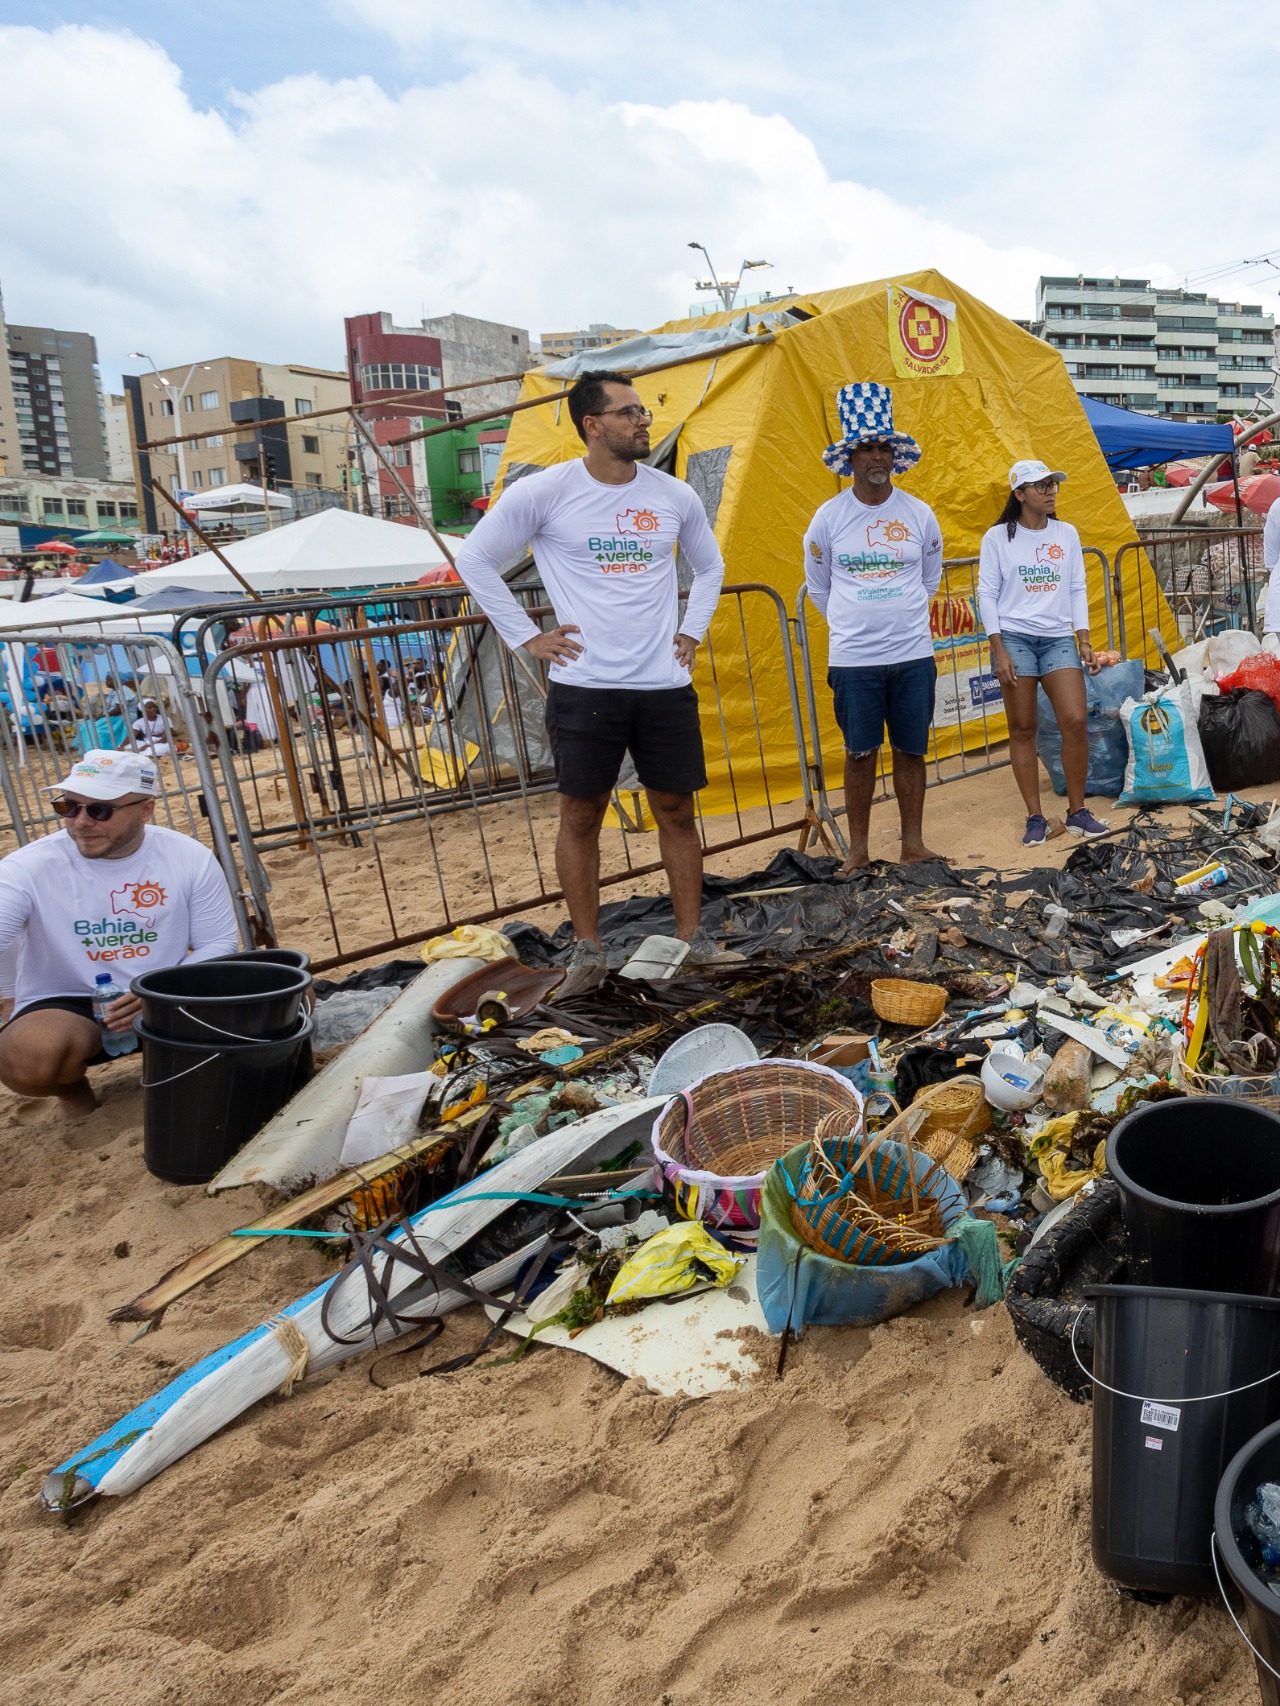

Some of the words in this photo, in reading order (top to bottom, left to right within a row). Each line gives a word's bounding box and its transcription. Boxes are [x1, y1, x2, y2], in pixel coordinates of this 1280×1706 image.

[588, 536, 638, 551] Bahia
[595, 547, 653, 562] +verde
[838, 551, 889, 566] Bahia
[600, 562, 647, 574] verão
[847, 559, 905, 574] +verde
[1018, 565, 1050, 576] Bahia
[1022, 571, 1061, 583] +verde
[1025, 582, 1057, 592] verão
[74, 918, 137, 936] Bahia
[81, 929, 158, 948] +verde
[86, 945, 151, 962] verão
